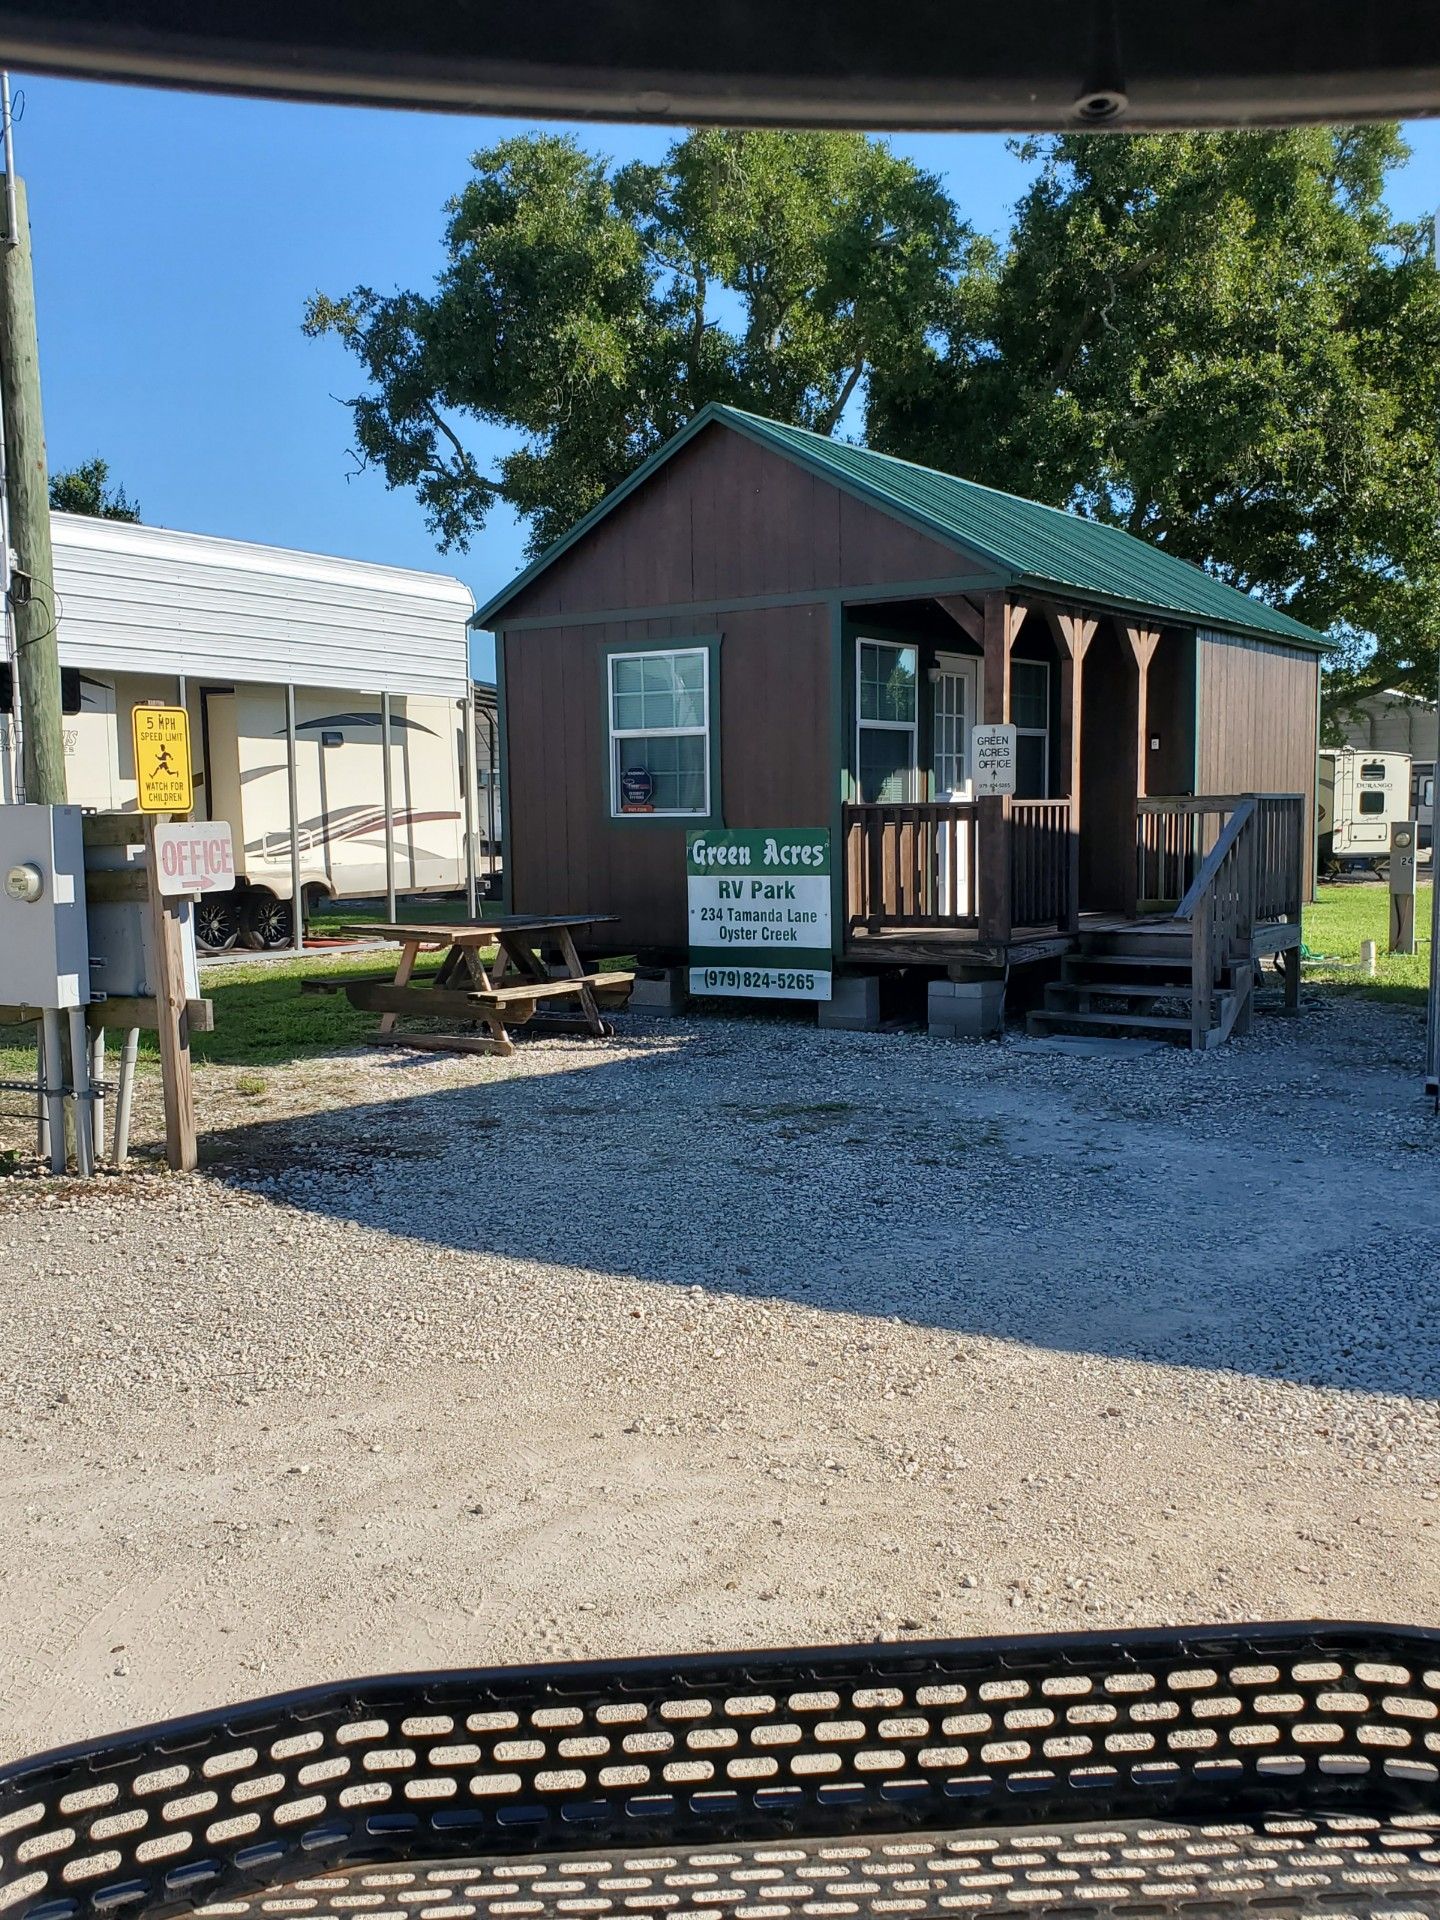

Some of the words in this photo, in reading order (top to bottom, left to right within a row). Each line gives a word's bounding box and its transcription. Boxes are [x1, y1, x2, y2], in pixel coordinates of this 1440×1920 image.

[146, 717, 154, 730] 5
[158, 716, 176, 731] MPH
[140, 732, 163, 742] SPEED
[165, 732, 183, 742] LIMIT
[977, 736, 1009, 746] GREEN
[978, 748, 1010, 757] ACRES
[978, 760, 1011, 769] OFFICE
[145, 781, 168, 791] WATCH
[170, 781, 184, 791] FOR
[148, 792, 183, 802] CHILDREN
[162, 838, 233, 877] OFFICE
[692, 839, 752, 866] Green
[763, 838, 824, 867] Acres
[1401, 857, 1414, 866] 24
[718, 880, 744, 899] RV
[751, 880, 796, 900] Park
[700, 907, 724, 922] 234
[727, 907, 783, 923] Tamanda
[787, 908, 818, 923] Lane
[719, 926, 758, 943] Oyster
[761, 926, 798, 942] Creek
